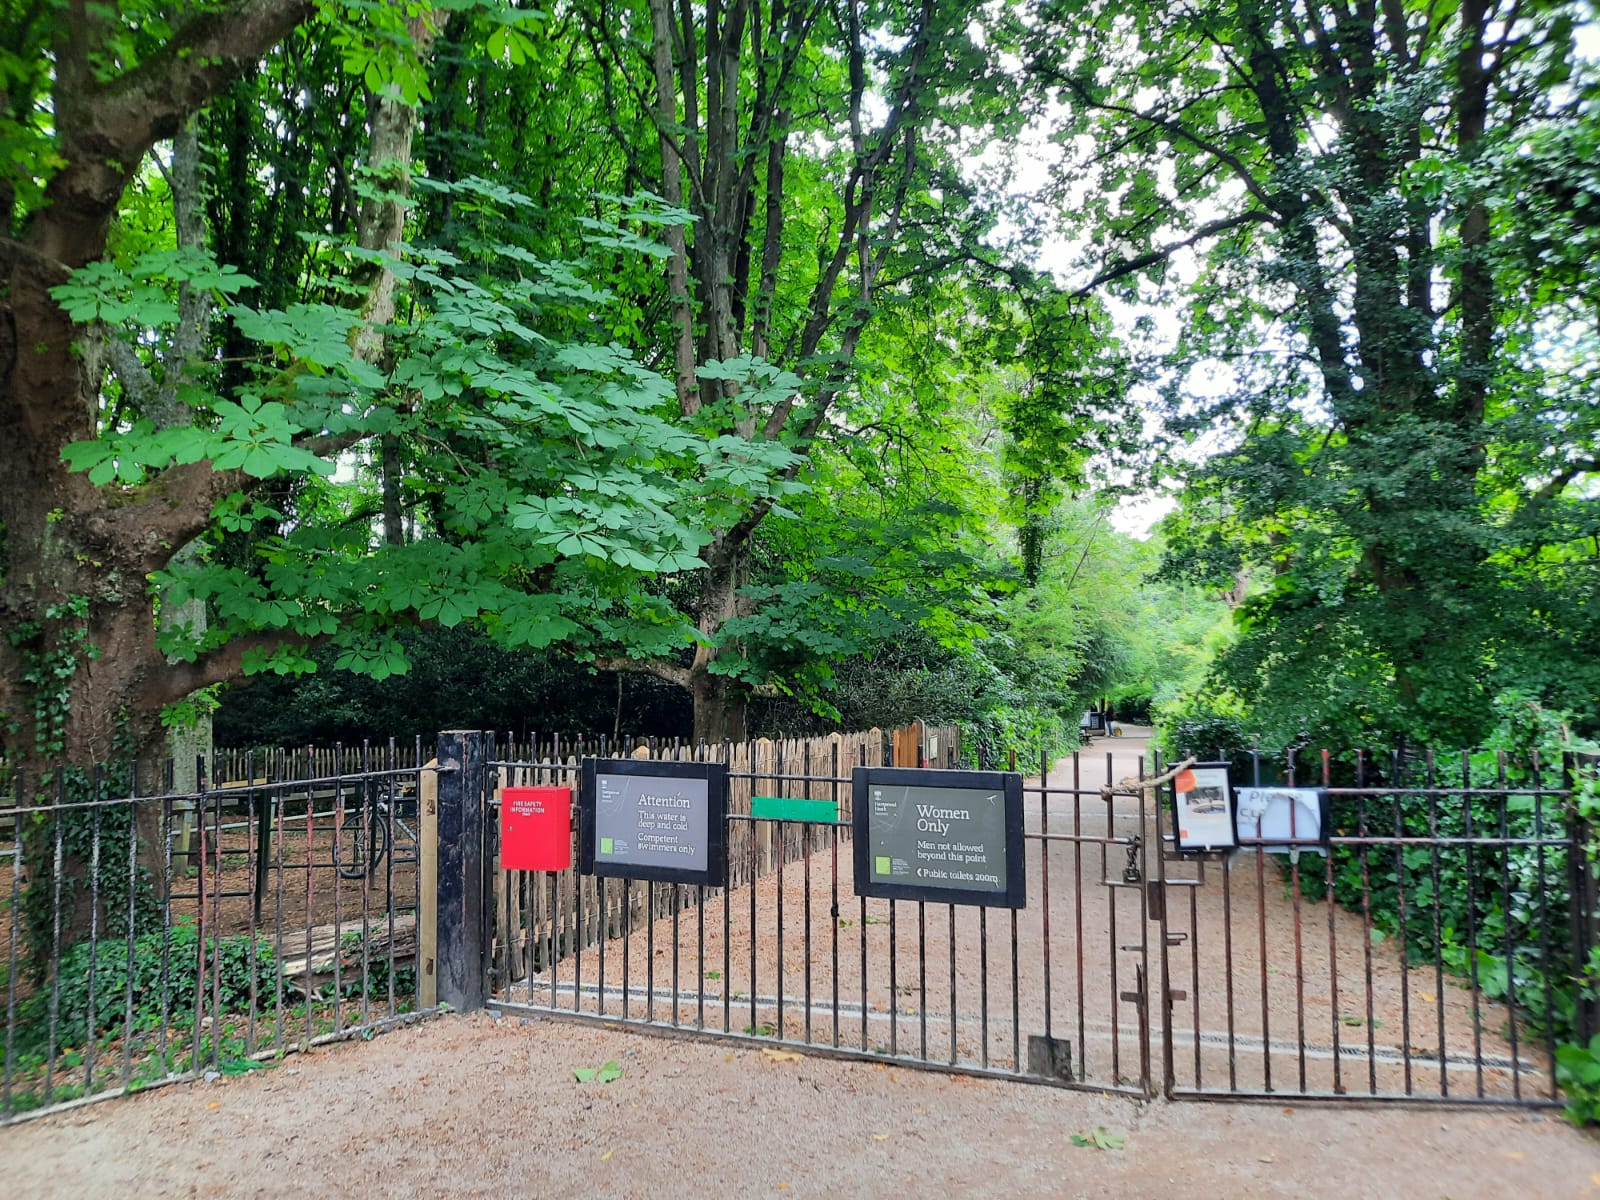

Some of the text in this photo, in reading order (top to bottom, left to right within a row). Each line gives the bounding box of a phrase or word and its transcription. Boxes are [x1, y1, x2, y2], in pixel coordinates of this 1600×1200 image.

[638, 793, 690, 808] Attention
[510, 806, 545, 814] INFORMATION
[638, 810, 687, 822] This water is
[916, 804, 970, 820] Women
[638, 819, 688, 831] deep and cold
[917, 818, 950, 837] Only
[637, 832, 678, 844] Competent
[637, 842, 677, 853] swimmers
[678, 844, 696, 857] only
[917, 840, 984, 853] Men not allowed
[917, 849, 987, 865] beyond this point
[923, 868, 948, 878] Public
[949, 871, 974, 881] toilets
